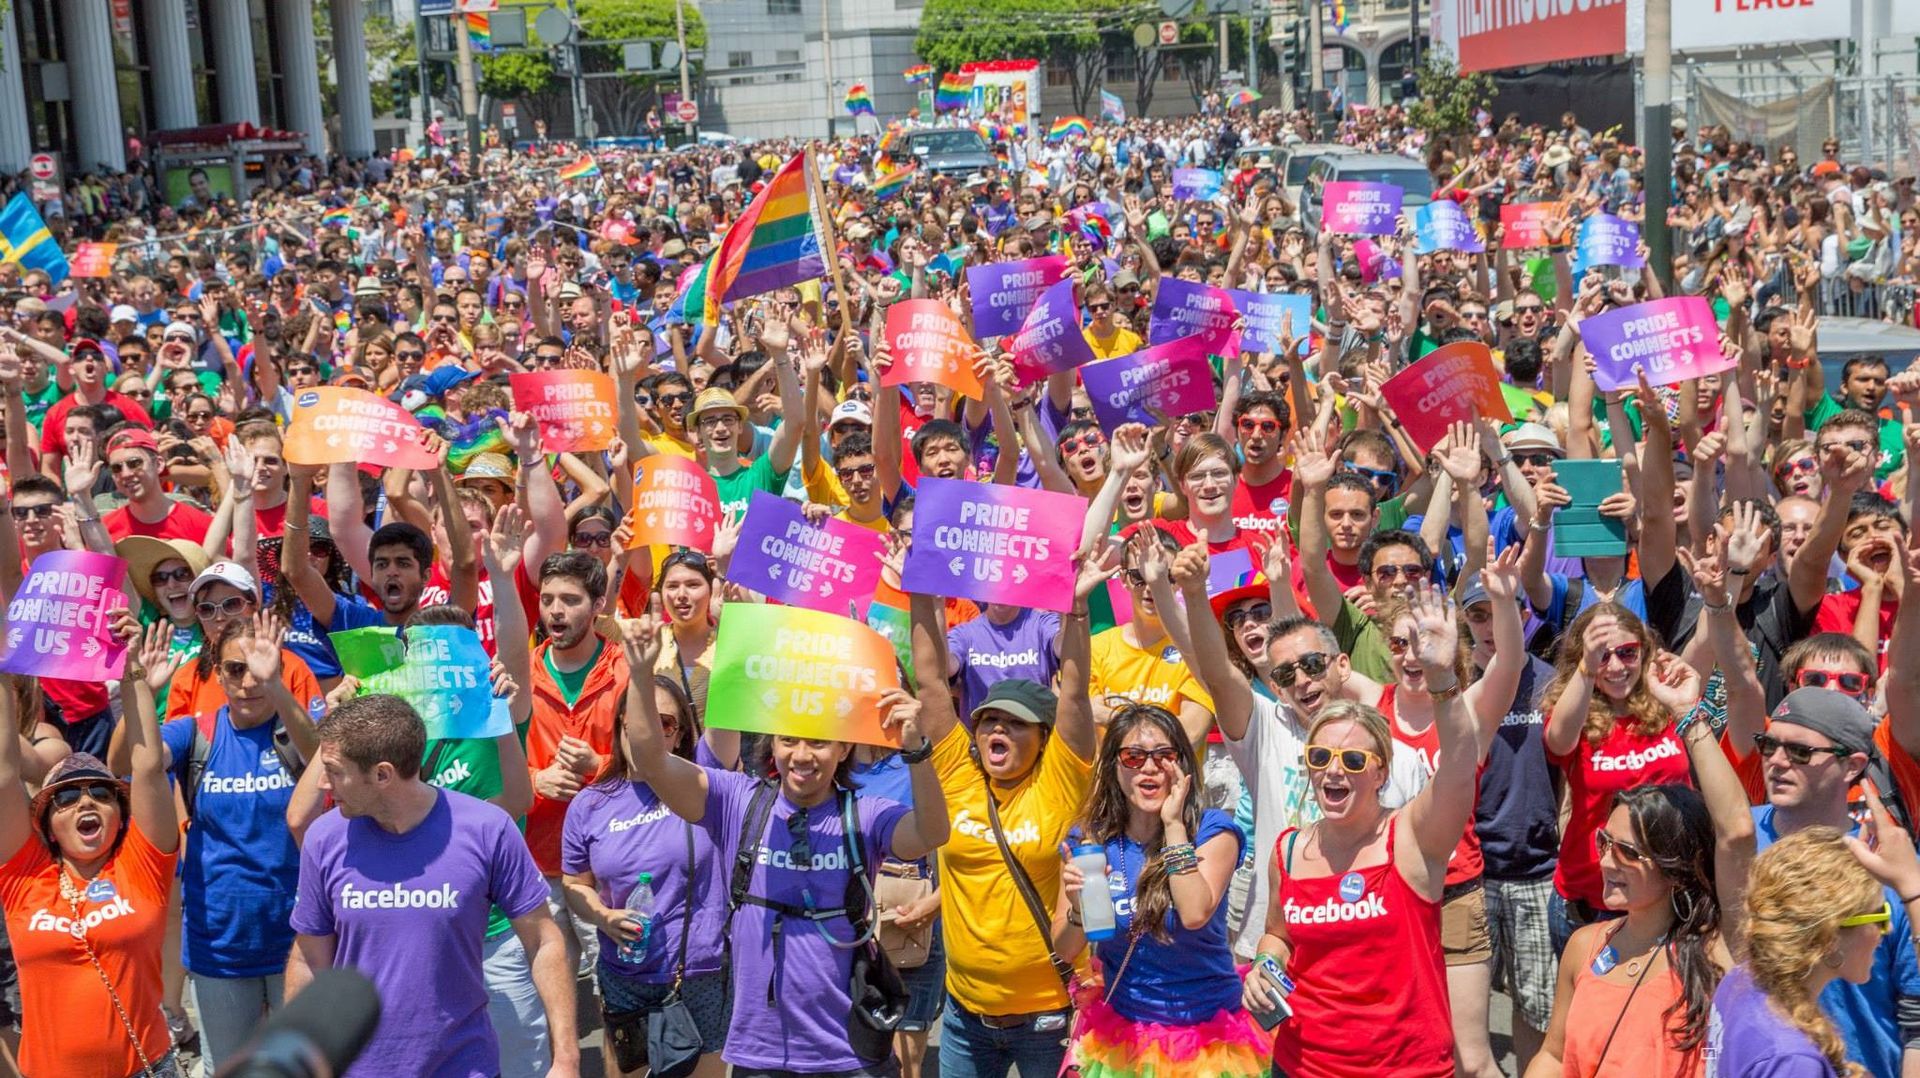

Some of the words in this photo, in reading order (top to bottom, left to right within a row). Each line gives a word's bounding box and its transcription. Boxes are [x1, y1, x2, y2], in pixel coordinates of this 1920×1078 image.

[1335, 202, 1391, 214] CONNECTS
[1347, 190, 1381, 202] PRIDE
[1356, 214, 1370, 225] US
[1002, 270, 1045, 289] PRIDE
[1186, 292, 1222, 312] PRIDE
[1247, 301, 1282, 315] PRIDE
[911, 313, 959, 336] PRIDE
[1170, 307, 1231, 329] CONNECTS
[1622, 311, 1680, 338] PRIDE
[896, 332, 974, 360] CONNECTS
[1610, 325, 1704, 362] CONNECTS
[921, 352, 944, 369] US
[1120, 358, 1171, 387] PRIDE
[1423, 354, 1475, 388] PRIDE
[1648, 352, 1676, 373] US
[543, 383, 595, 401] PRIDE
[1109, 369, 1191, 409] CONNECTS
[336, 398, 399, 420] PRIDE
[532, 401, 612, 420] CONNECTS
[313, 414, 418, 441] CONNECTS
[348, 431, 376, 449] US
[563, 421, 585, 438] US
[653, 468, 702, 493] PRIDE
[638, 490, 714, 518] CONNECTS
[959, 500, 1031, 531] PRIDE
[664, 510, 689, 529] US
[785, 520, 845, 556] PRIDE
[934, 525, 1050, 561] CONNECTS
[761, 535, 857, 583] CONNECTS
[973, 557, 1004, 582] US
[25, 570, 104, 600] PRIDE
[787, 568, 814, 592] US
[34, 628, 71, 655] US
[774, 627, 854, 660] PRIDE
[968, 648, 1039, 669] facebook
[744, 655, 876, 692] CONNECTS
[791, 689, 825, 715] US
[202, 766, 295, 794] facebook
[341, 881, 459, 910] facebook
[1283, 891, 1388, 924] facebook
